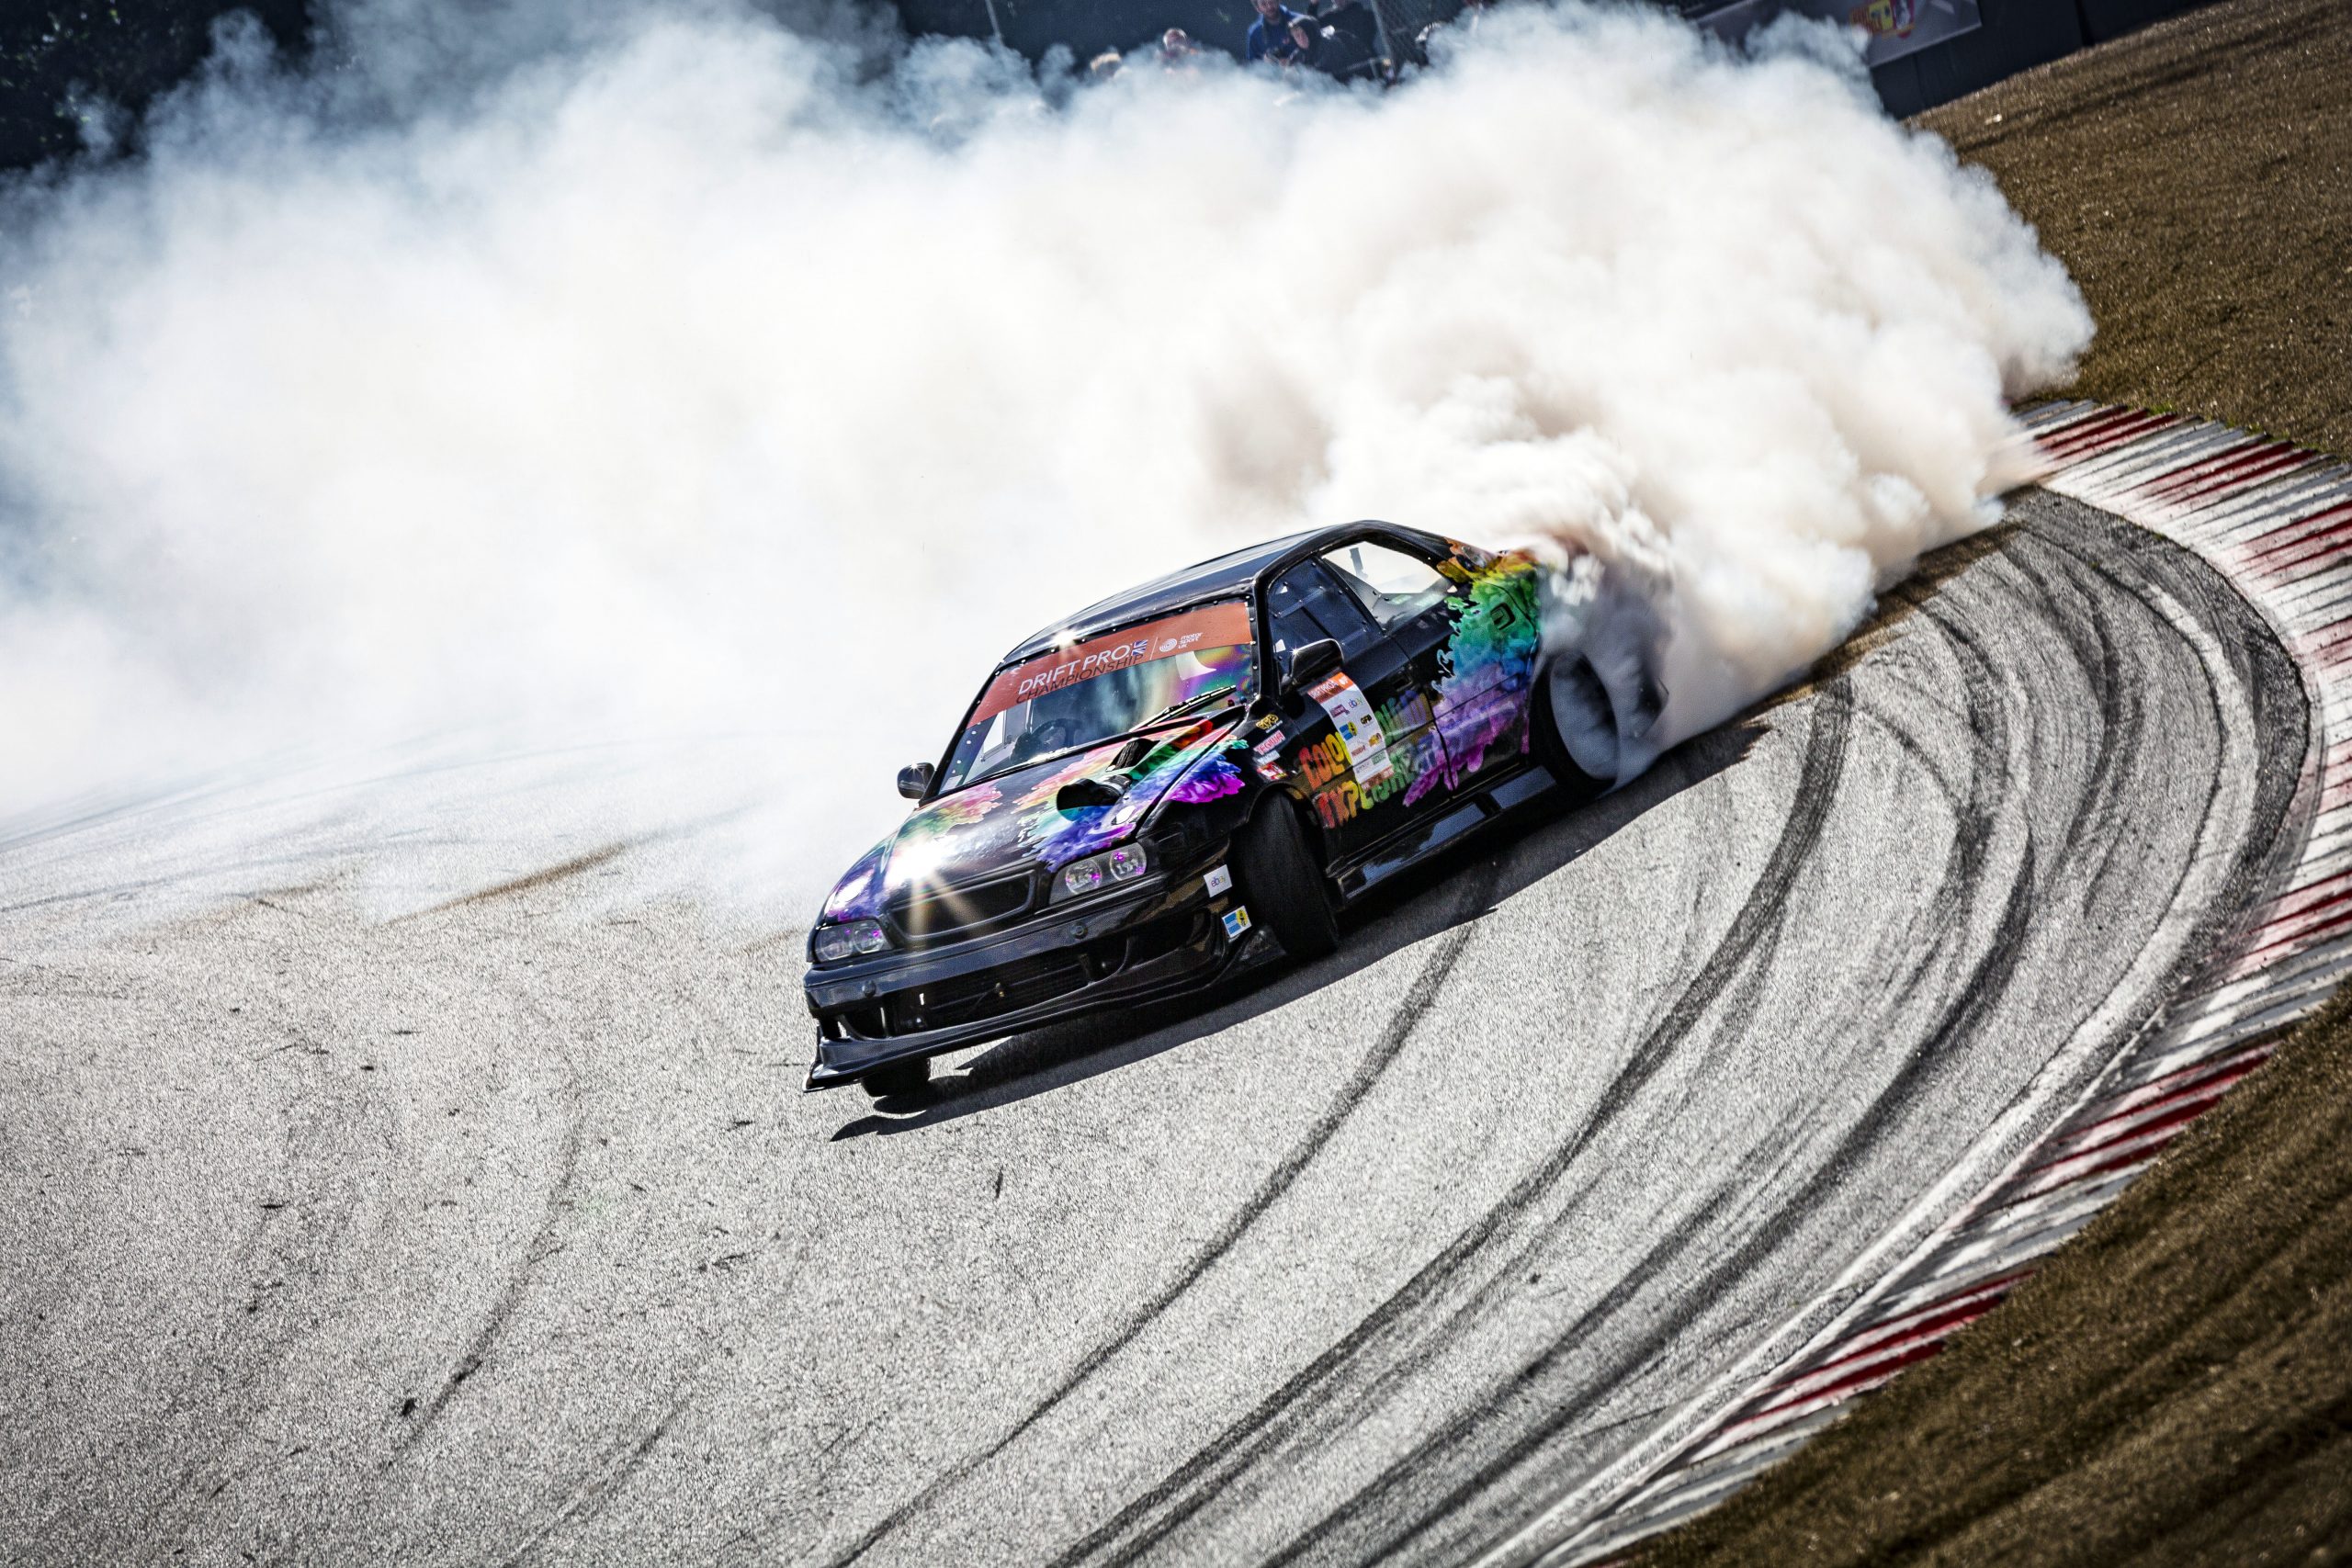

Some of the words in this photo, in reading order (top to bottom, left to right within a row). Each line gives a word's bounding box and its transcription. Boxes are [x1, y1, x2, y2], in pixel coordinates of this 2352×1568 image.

[1015, 653, 1145, 705] CHAMPIONSHIP
[1018, 660, 1081, 695] DRIFT
[1082, 644, 1132, 671] PRO
